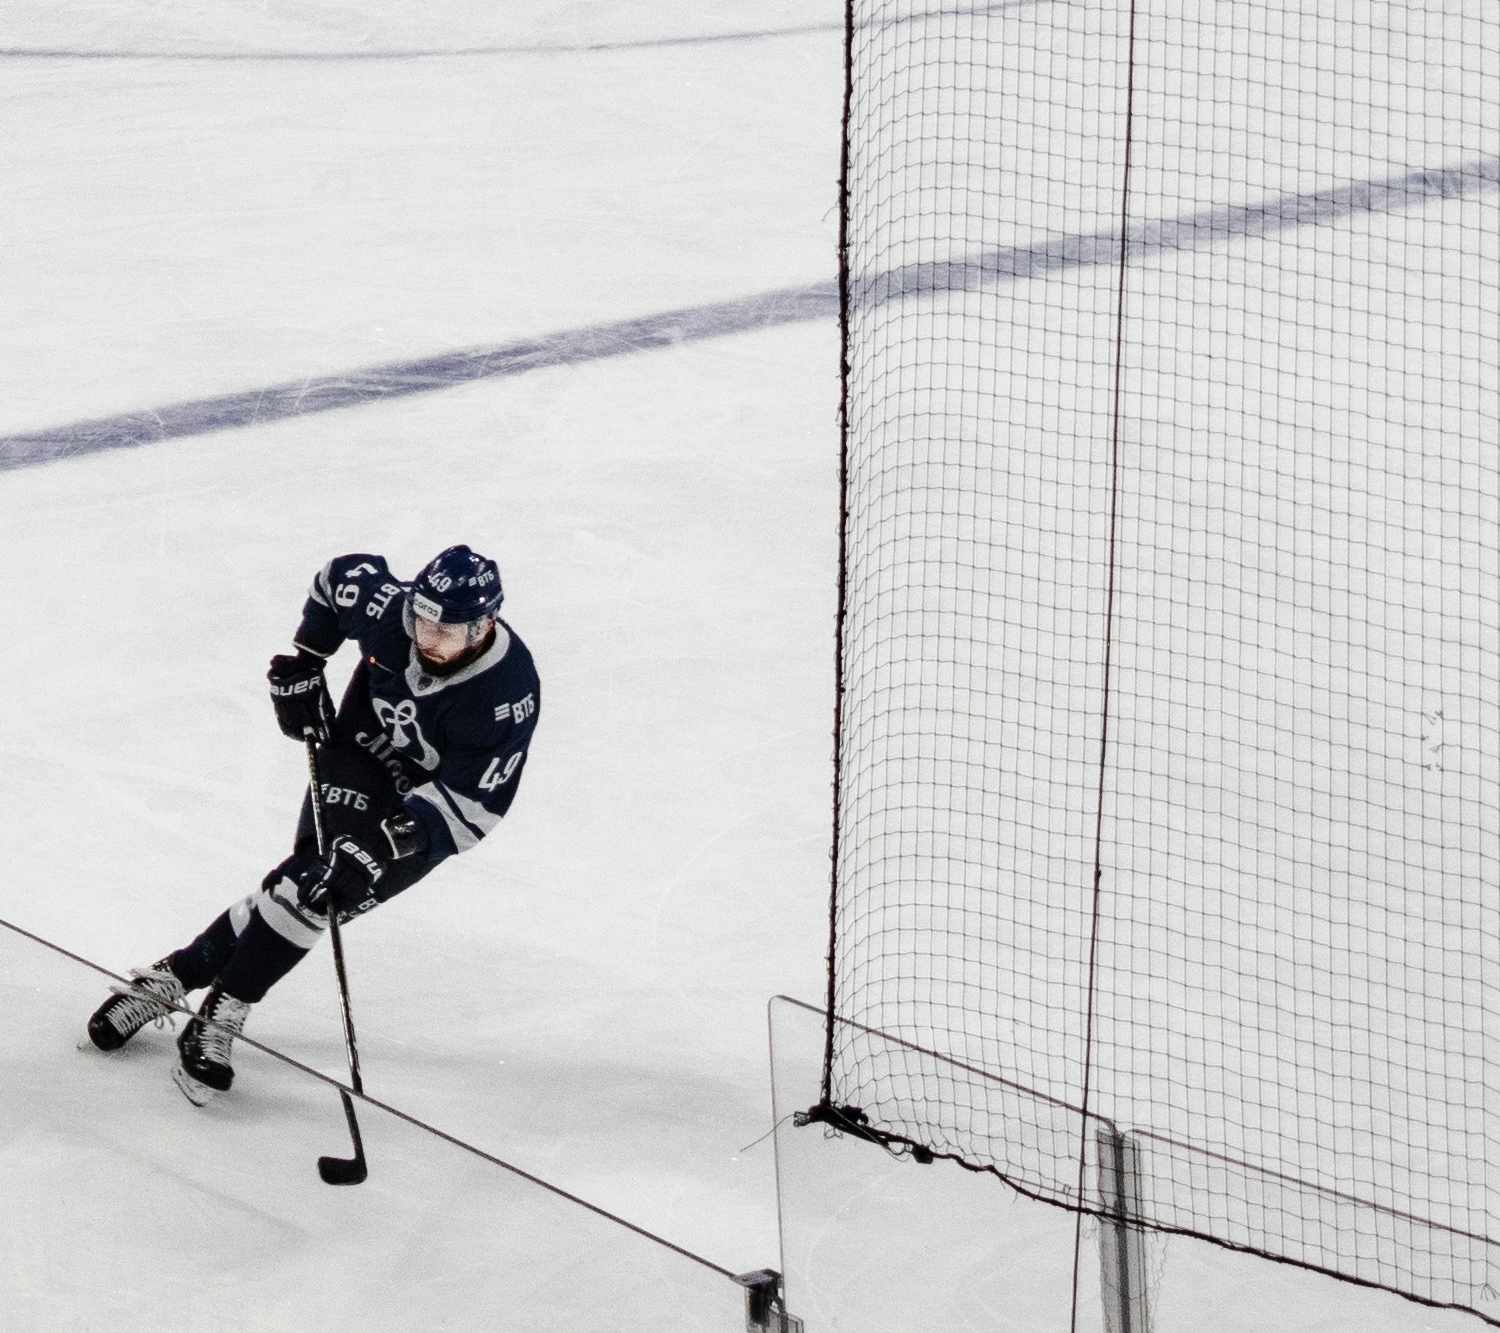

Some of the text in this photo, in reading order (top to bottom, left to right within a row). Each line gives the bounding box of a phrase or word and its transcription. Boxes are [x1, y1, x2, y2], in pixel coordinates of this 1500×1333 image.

[428, 572, 453, 594] 49
[365, 582, 401, 620] ВТБ
[512, 693, 536, 725] ВТБ
[478, 750, 523, 792] 49
[326, 786, 370, 813] ВТБ
